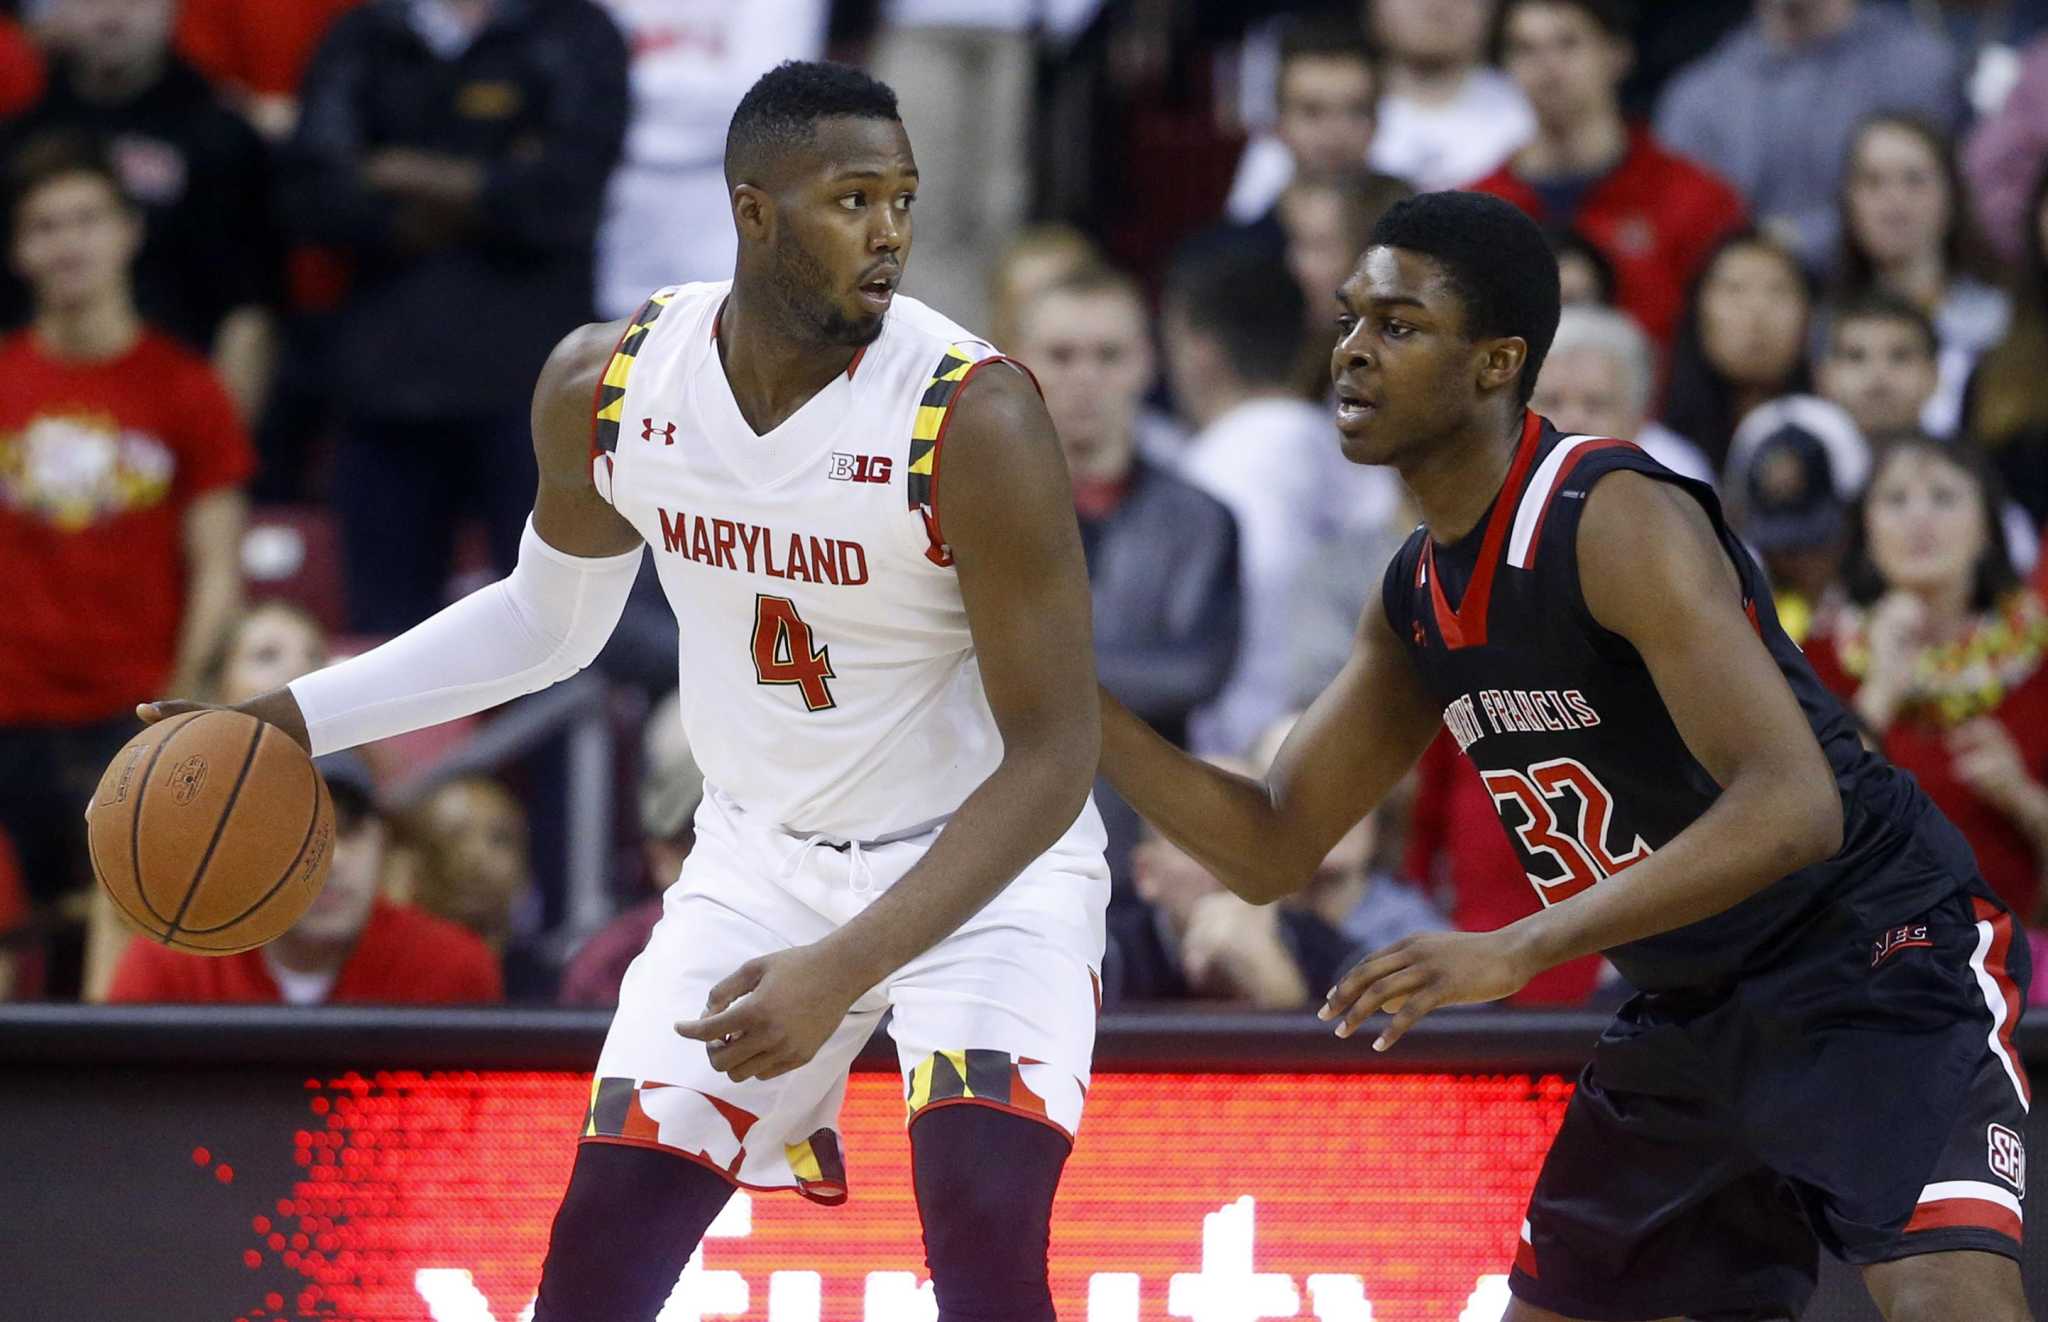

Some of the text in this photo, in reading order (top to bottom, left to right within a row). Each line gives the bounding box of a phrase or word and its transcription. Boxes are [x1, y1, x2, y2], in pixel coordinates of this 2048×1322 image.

[657, 507, 870, 586] MARYLAND
[750, 593, 837, 712] 4
[1479, 689, 1601, 734] FRANCIS
[1480, 757, 1653, 908] 32
